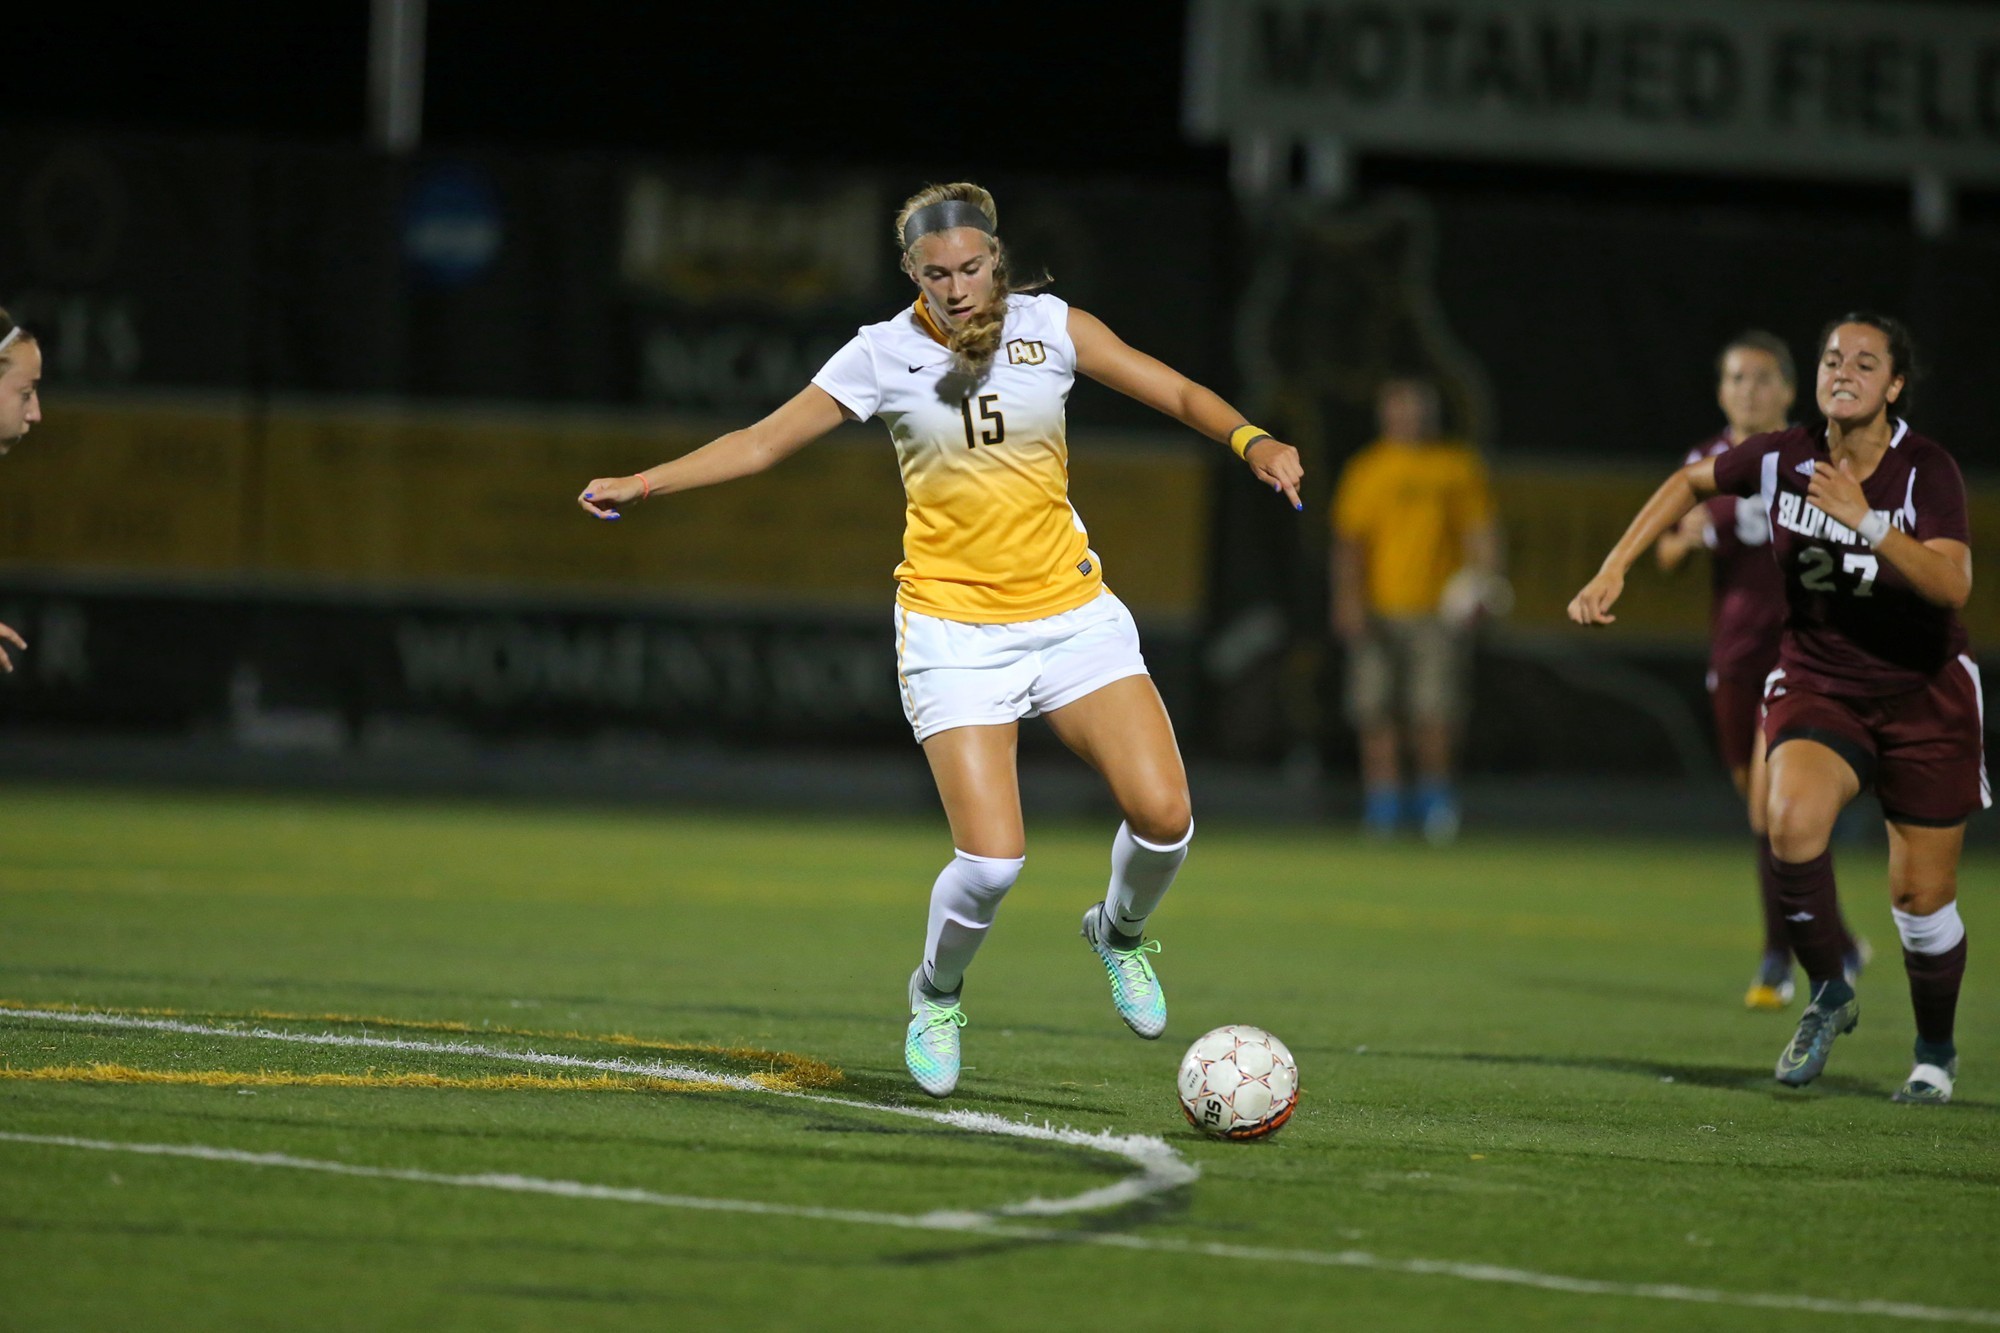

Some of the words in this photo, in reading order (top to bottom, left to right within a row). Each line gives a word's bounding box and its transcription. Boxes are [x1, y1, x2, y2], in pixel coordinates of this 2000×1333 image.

[1006, 338, 1046, 365] AU
[961, 394, 1005, 449] 15
[1798, 546, 1879, 597] 27
